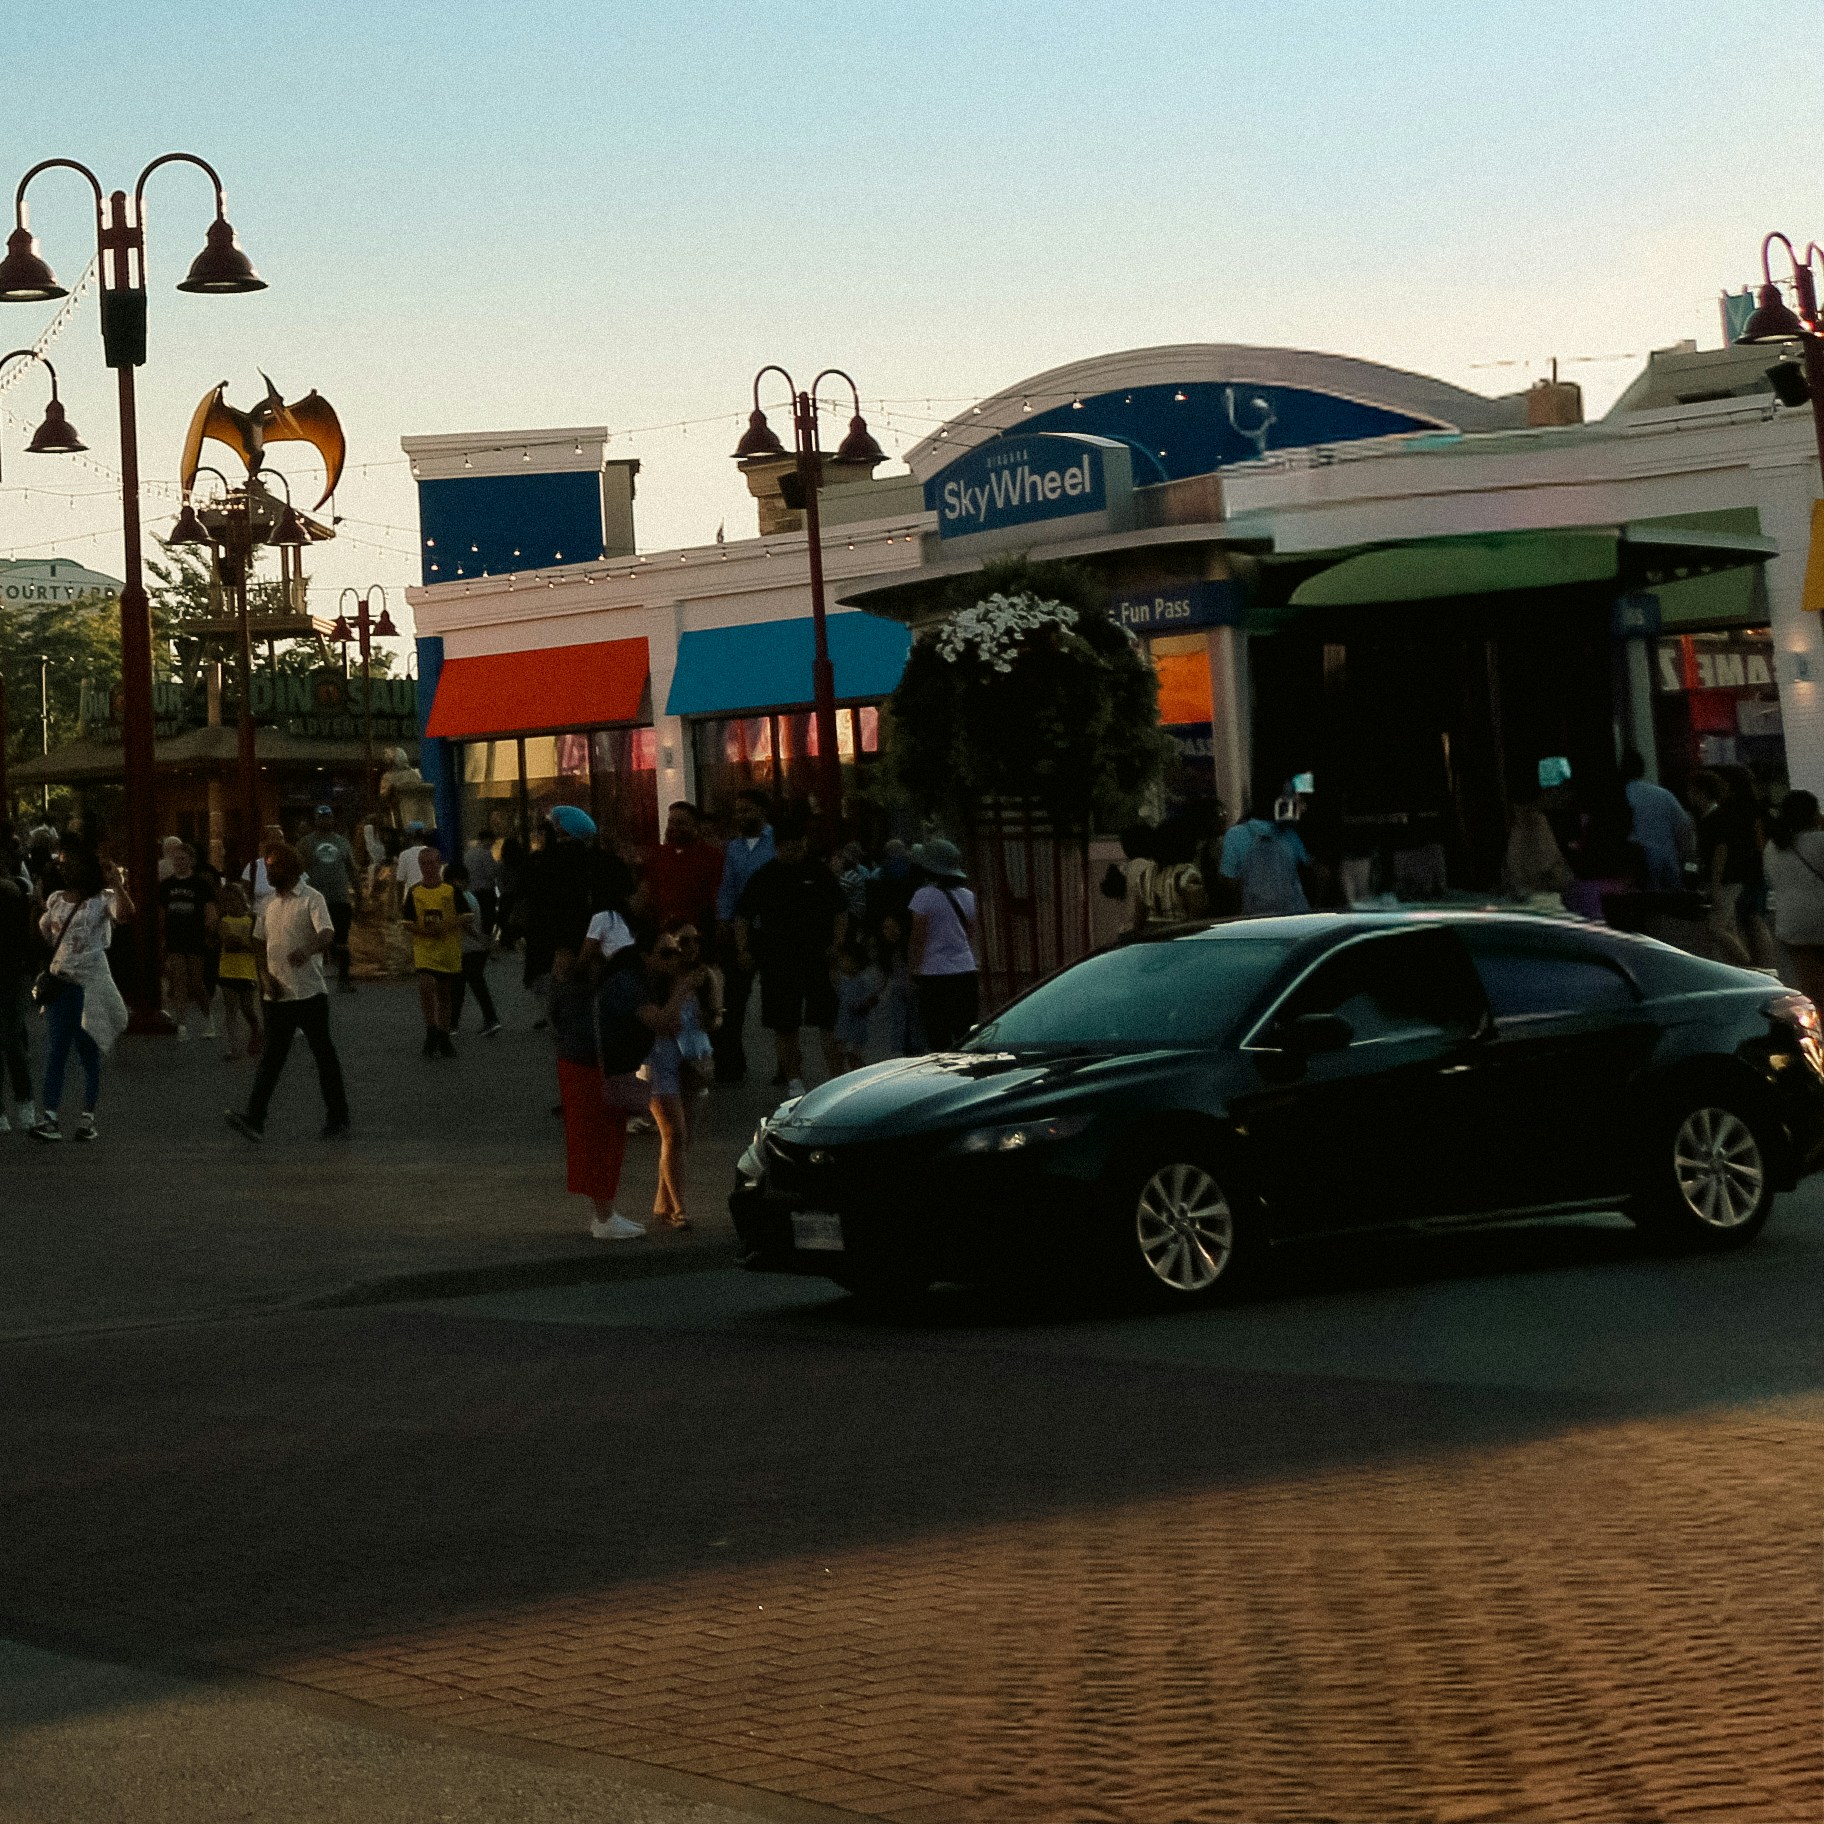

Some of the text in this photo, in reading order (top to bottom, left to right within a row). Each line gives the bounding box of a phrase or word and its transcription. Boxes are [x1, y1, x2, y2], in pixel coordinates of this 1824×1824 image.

[943, 453, 1092, 523] SkyWheel
[1120, 597, 1191, 624] Fun Pass
